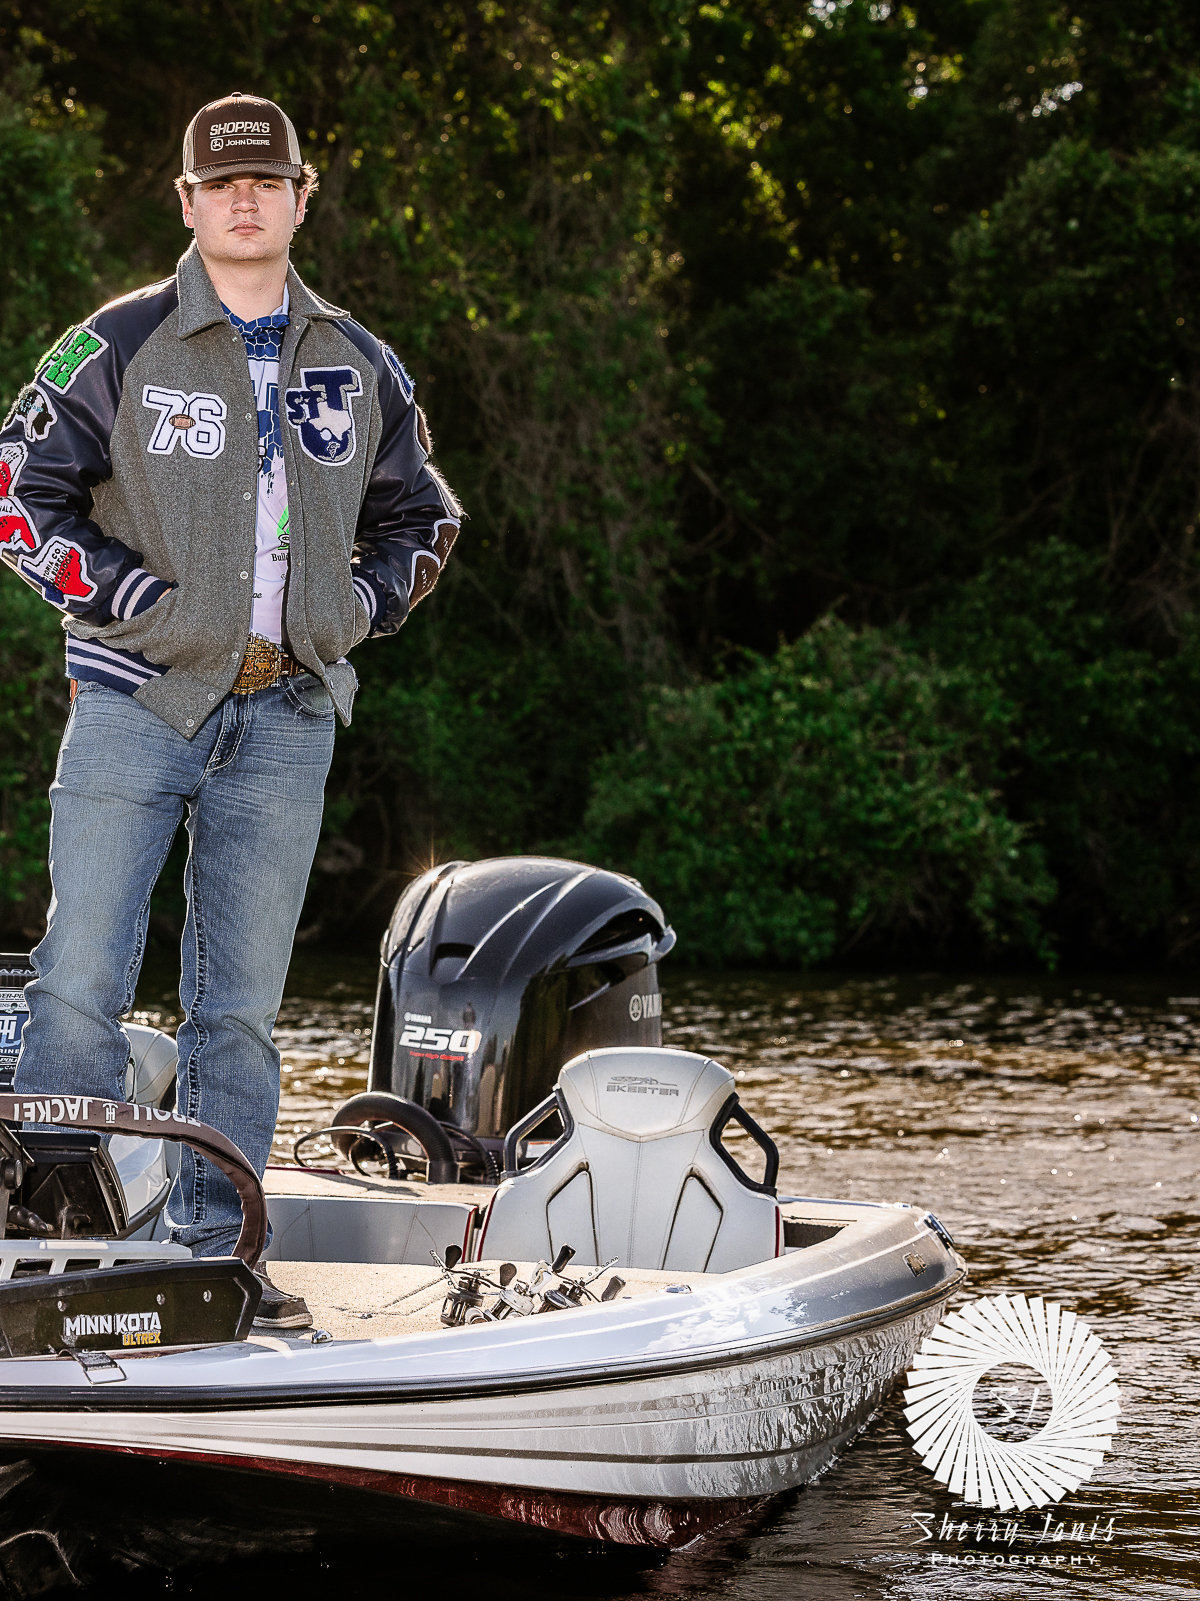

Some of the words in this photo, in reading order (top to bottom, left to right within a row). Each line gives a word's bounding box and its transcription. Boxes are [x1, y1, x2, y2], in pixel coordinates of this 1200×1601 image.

[210, 121, 270, 136] SHOPPA'S
[225, 139, 246, 147] JOHN
[246, 138, 271, 146] DEERE
[146, 388, 224, 457] 76
[51, 549, 68, 576] BUREAU
[399, 1024, 482, 1054] 250
[606, 1084, 680, 1097] SKEETER
[63, 1314, 113, 1337] MINN
[114, 1312, 161, 1334] KOTA
[122, 1332, 161, 1346] ULTREX
